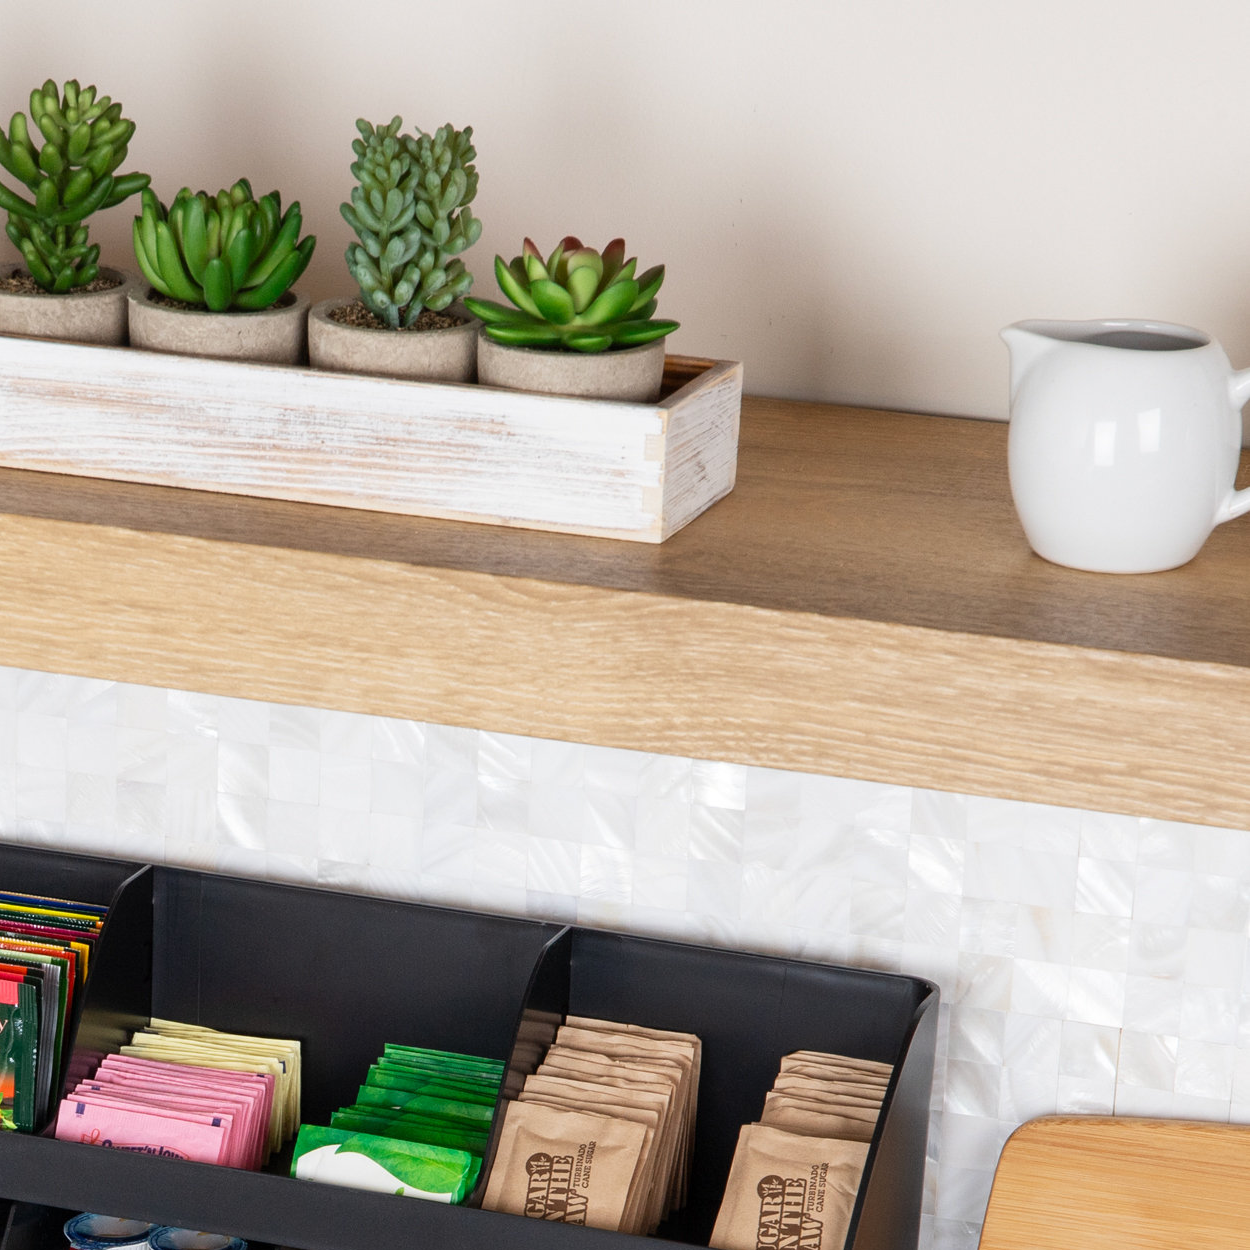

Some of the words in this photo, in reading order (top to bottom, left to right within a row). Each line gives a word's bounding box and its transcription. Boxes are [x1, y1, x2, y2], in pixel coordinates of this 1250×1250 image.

[573, 1143, 587, 1188] TURBINADO
[585, 1141, 596, 1165] SUGAR
[582, 1165, 592, 1188] CANE
[819, 1162, 829, 1188] SUGAR
[807, 1164, 820, 1212] TURBINADO
[816, 1189, 826, 1213] CANE
